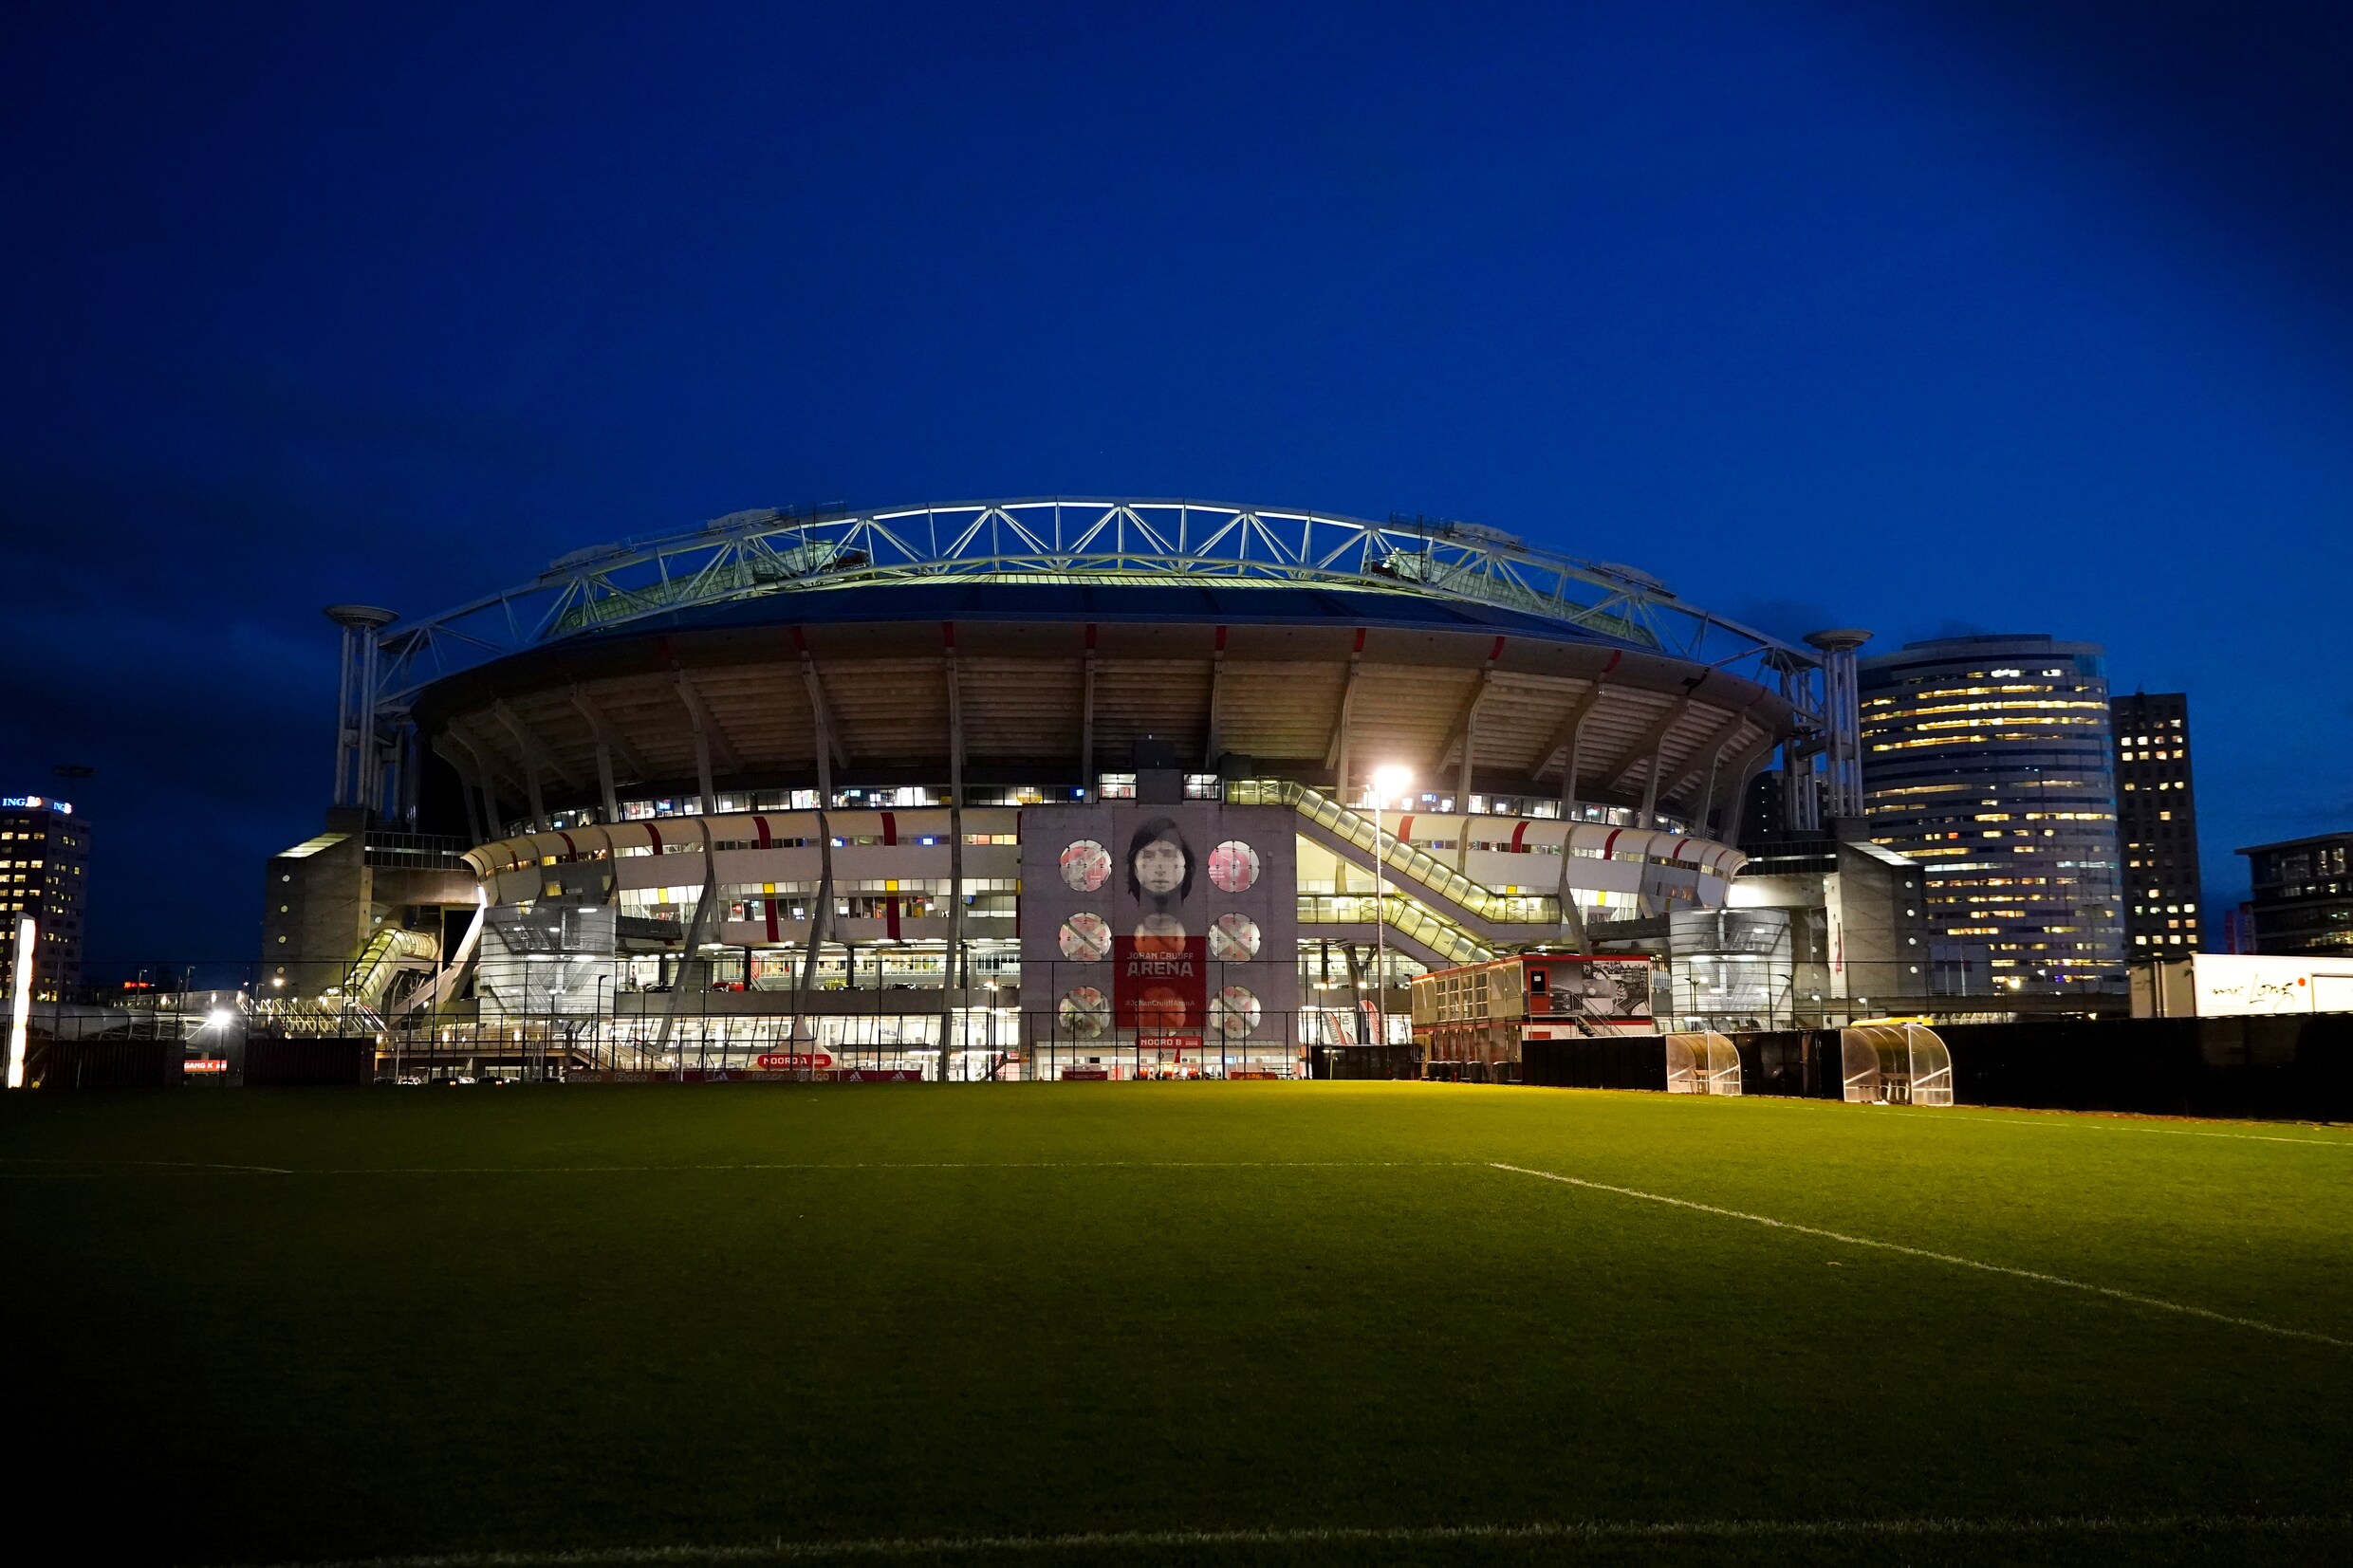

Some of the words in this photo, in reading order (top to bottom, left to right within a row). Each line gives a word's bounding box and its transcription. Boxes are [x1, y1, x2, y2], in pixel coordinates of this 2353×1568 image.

[3, 798, 26, 806] ING
[53, 802, 65, 812] ING
[1127, 951, 1158, 960] JOHAN
[1126, 961, 1194, 977] ARENA
[2249, 973, 2294, 1013] Long
[763, 1057, 798, 1065] NOORD
